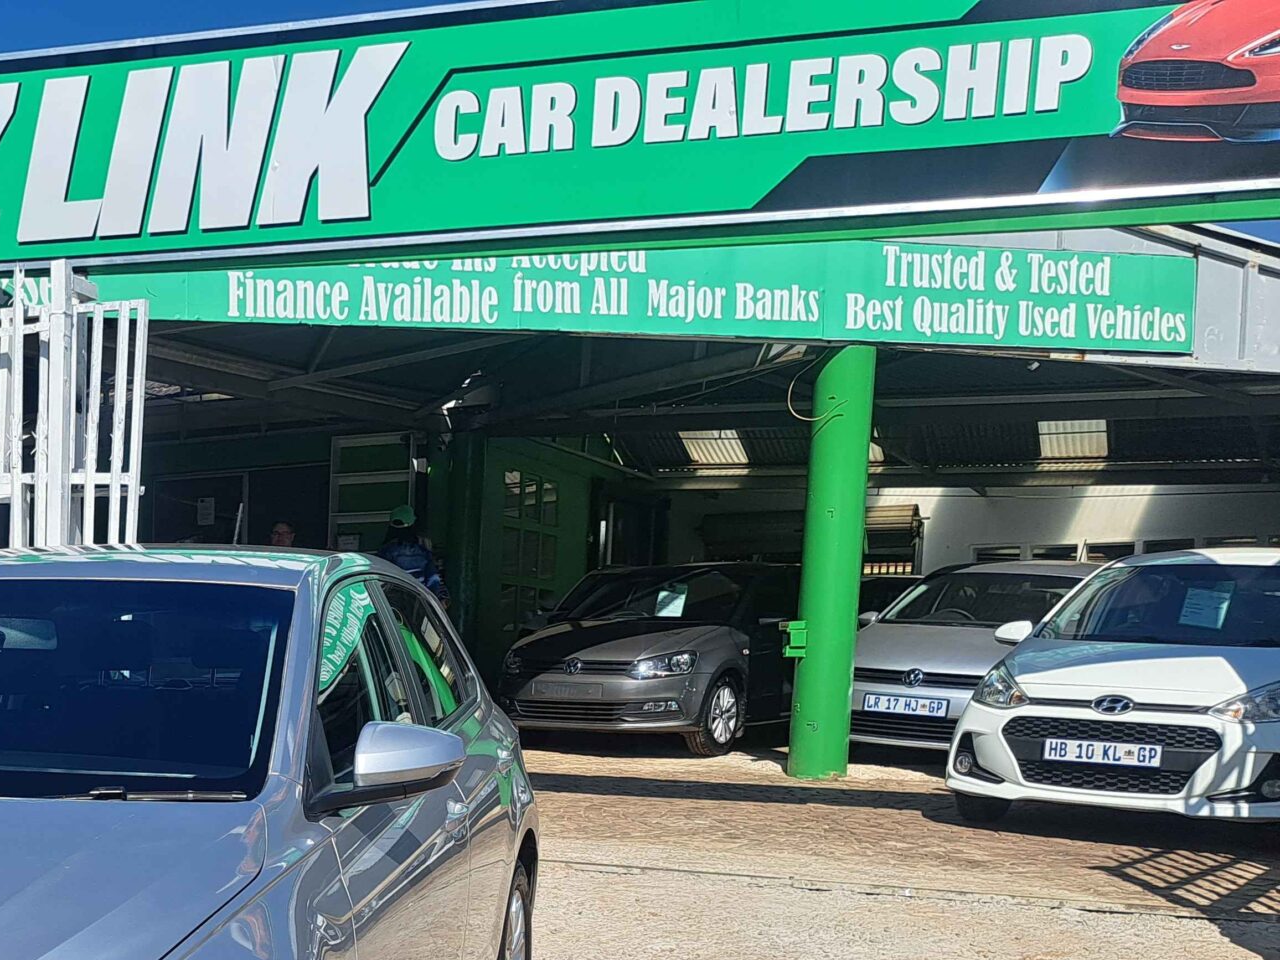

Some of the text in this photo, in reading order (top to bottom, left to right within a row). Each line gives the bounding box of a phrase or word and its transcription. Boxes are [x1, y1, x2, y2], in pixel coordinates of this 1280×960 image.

[17, 41, 411, 243] LINK
[433, 80, 576, 160] CAR
[591, 34, 1093, 149] DEALERSHIP
[883, 246, 1111, 296] Trusted & Tested
[227, 270, 819, 323] Finance Available from All Major Banks
[845, 292, 1187, 342] Best Quality Used Vehicles
[867, 696, 943, 714] LR 17 HJ GP
[1048, 741, 1157, 764] HB 10 KL GP
